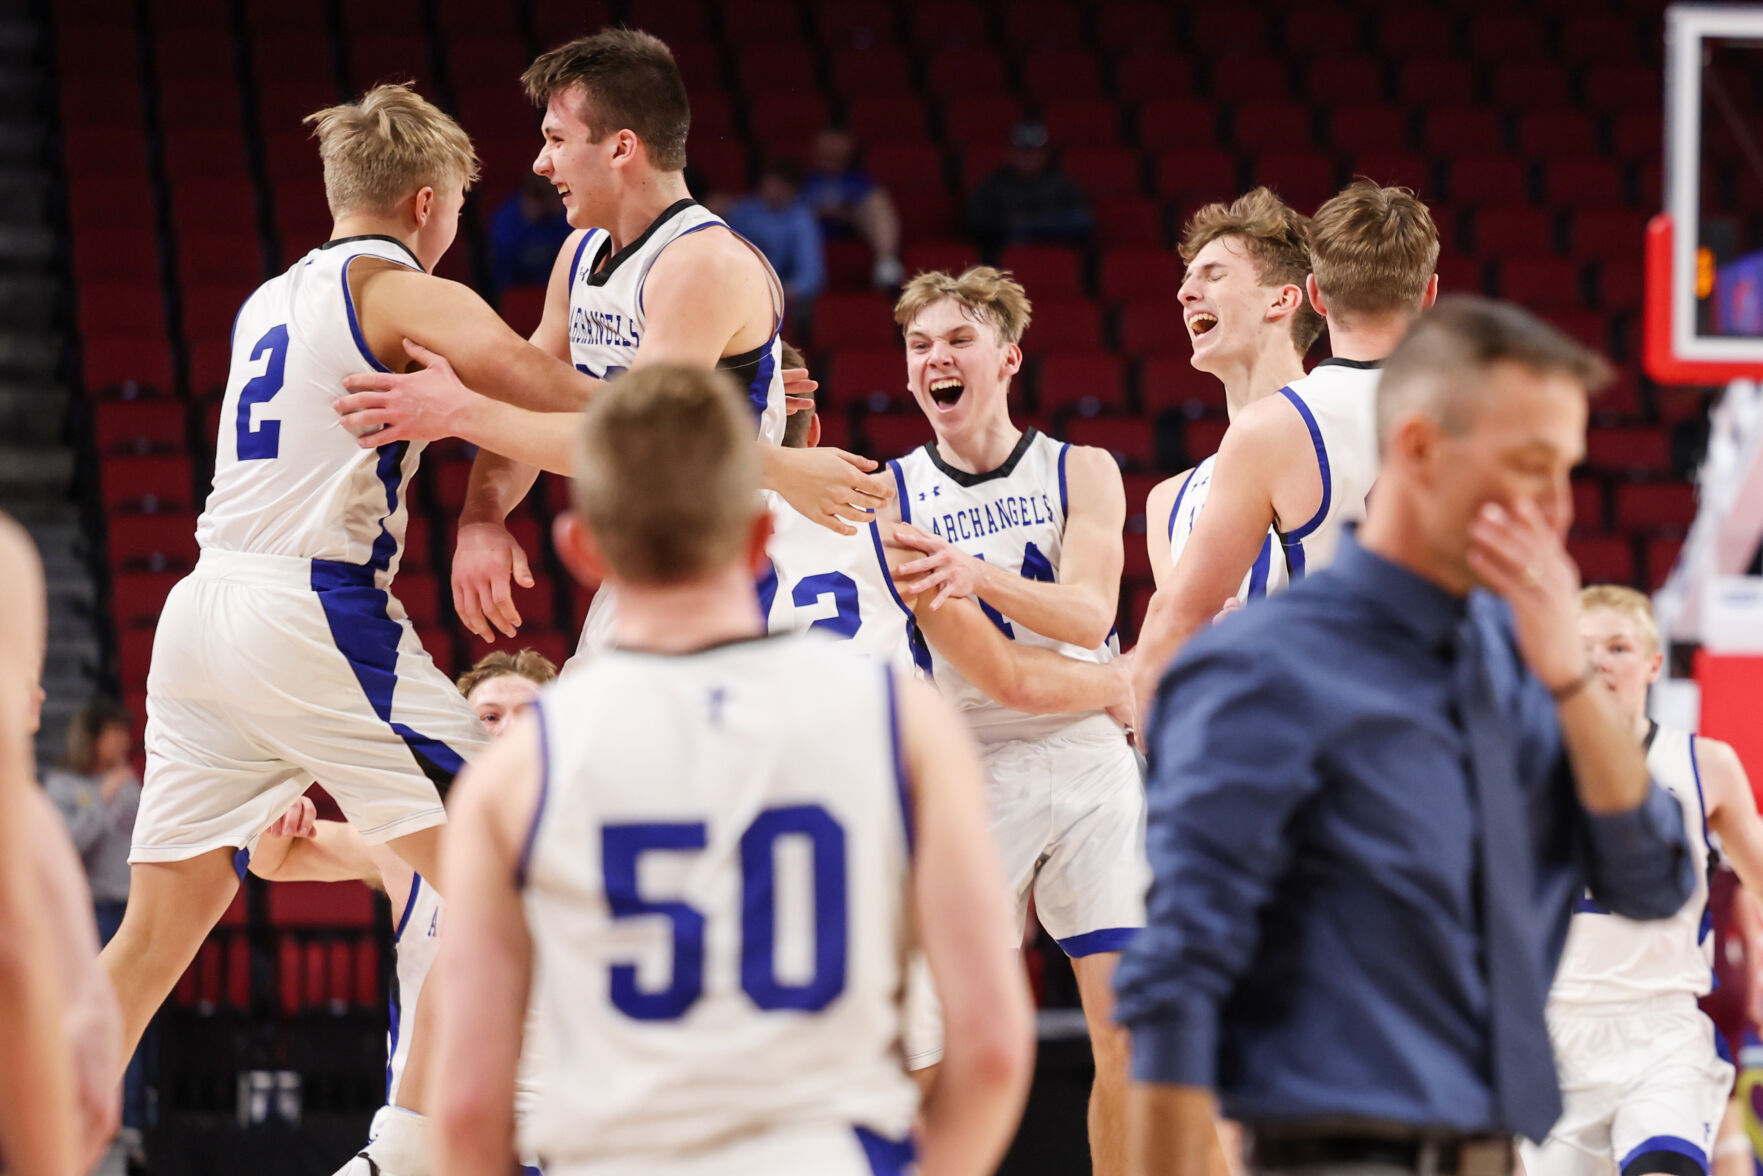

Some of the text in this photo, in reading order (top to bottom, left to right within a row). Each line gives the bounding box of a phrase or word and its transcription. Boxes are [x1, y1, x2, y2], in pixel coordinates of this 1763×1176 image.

[236, 323, 290, 461] 2
[932, 494, 1054, 545] ARCHANGELS
[599, 803, 848, 1022] 50
